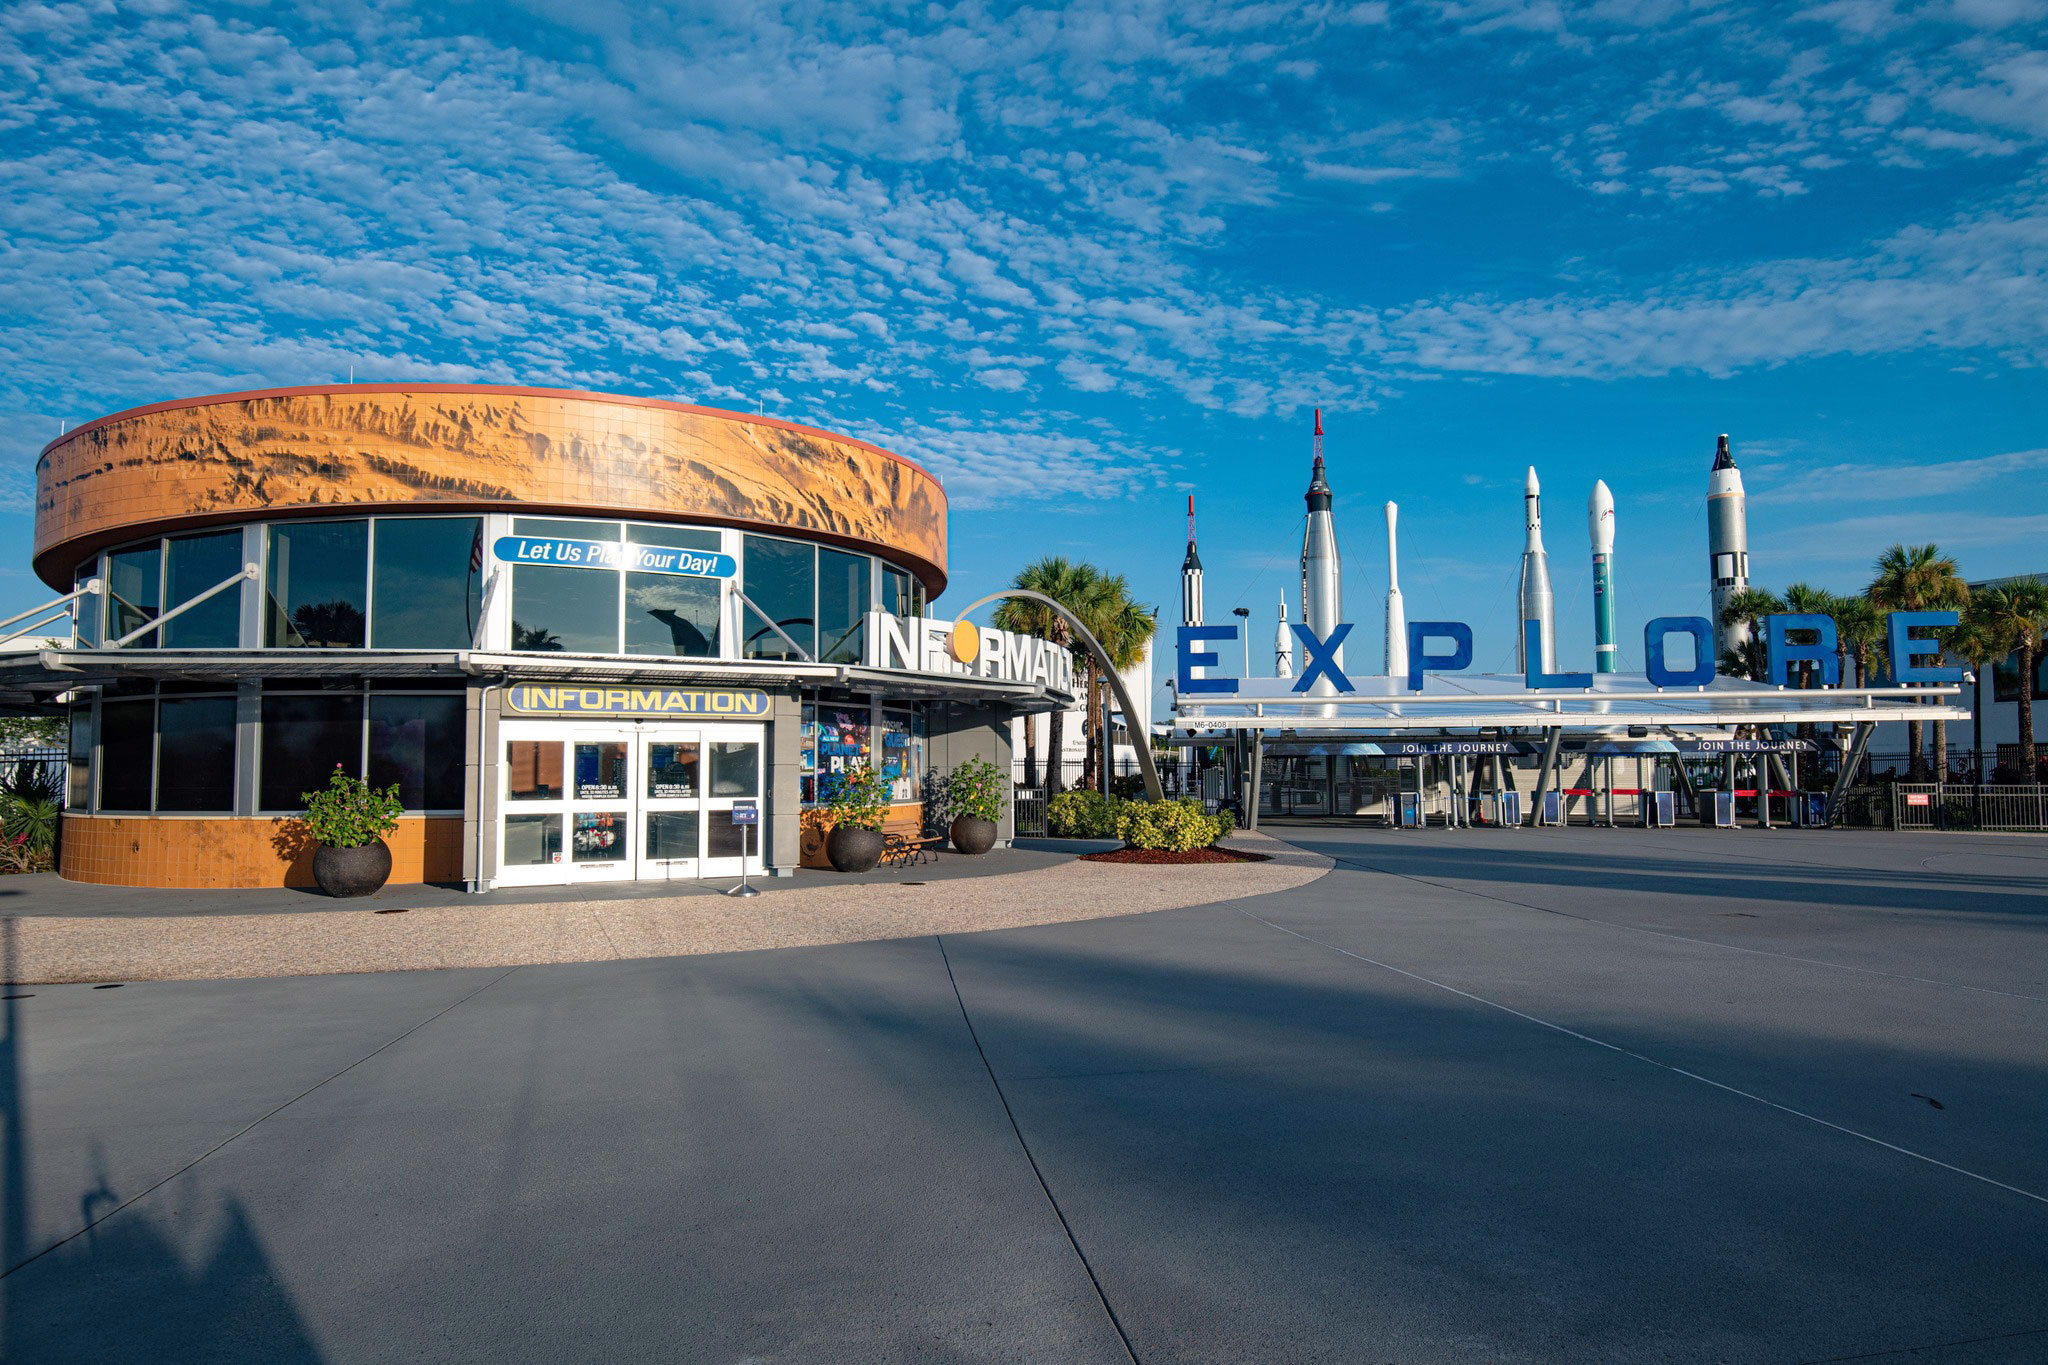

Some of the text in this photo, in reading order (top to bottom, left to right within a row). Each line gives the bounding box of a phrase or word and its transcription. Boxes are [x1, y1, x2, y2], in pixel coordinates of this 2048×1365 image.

[517, 540, 552, 561] Let
[556, 543, 581, 562] Us
[586, 545, 628, 565] Pla
[678, 554, 718, 576] Day!
[1177, 611, 1963, 693] EXPLORE
[522, 686, 757, 713] INFORMATION
[1194, 721, 1227, 729] M6-0408
[821, 743, 860, 756] PLANET
[1402, 743, 1509, 753] JOIN THE JOURNEY
[1697, 741, 1808, 751] JOIN THE JOURNEY
